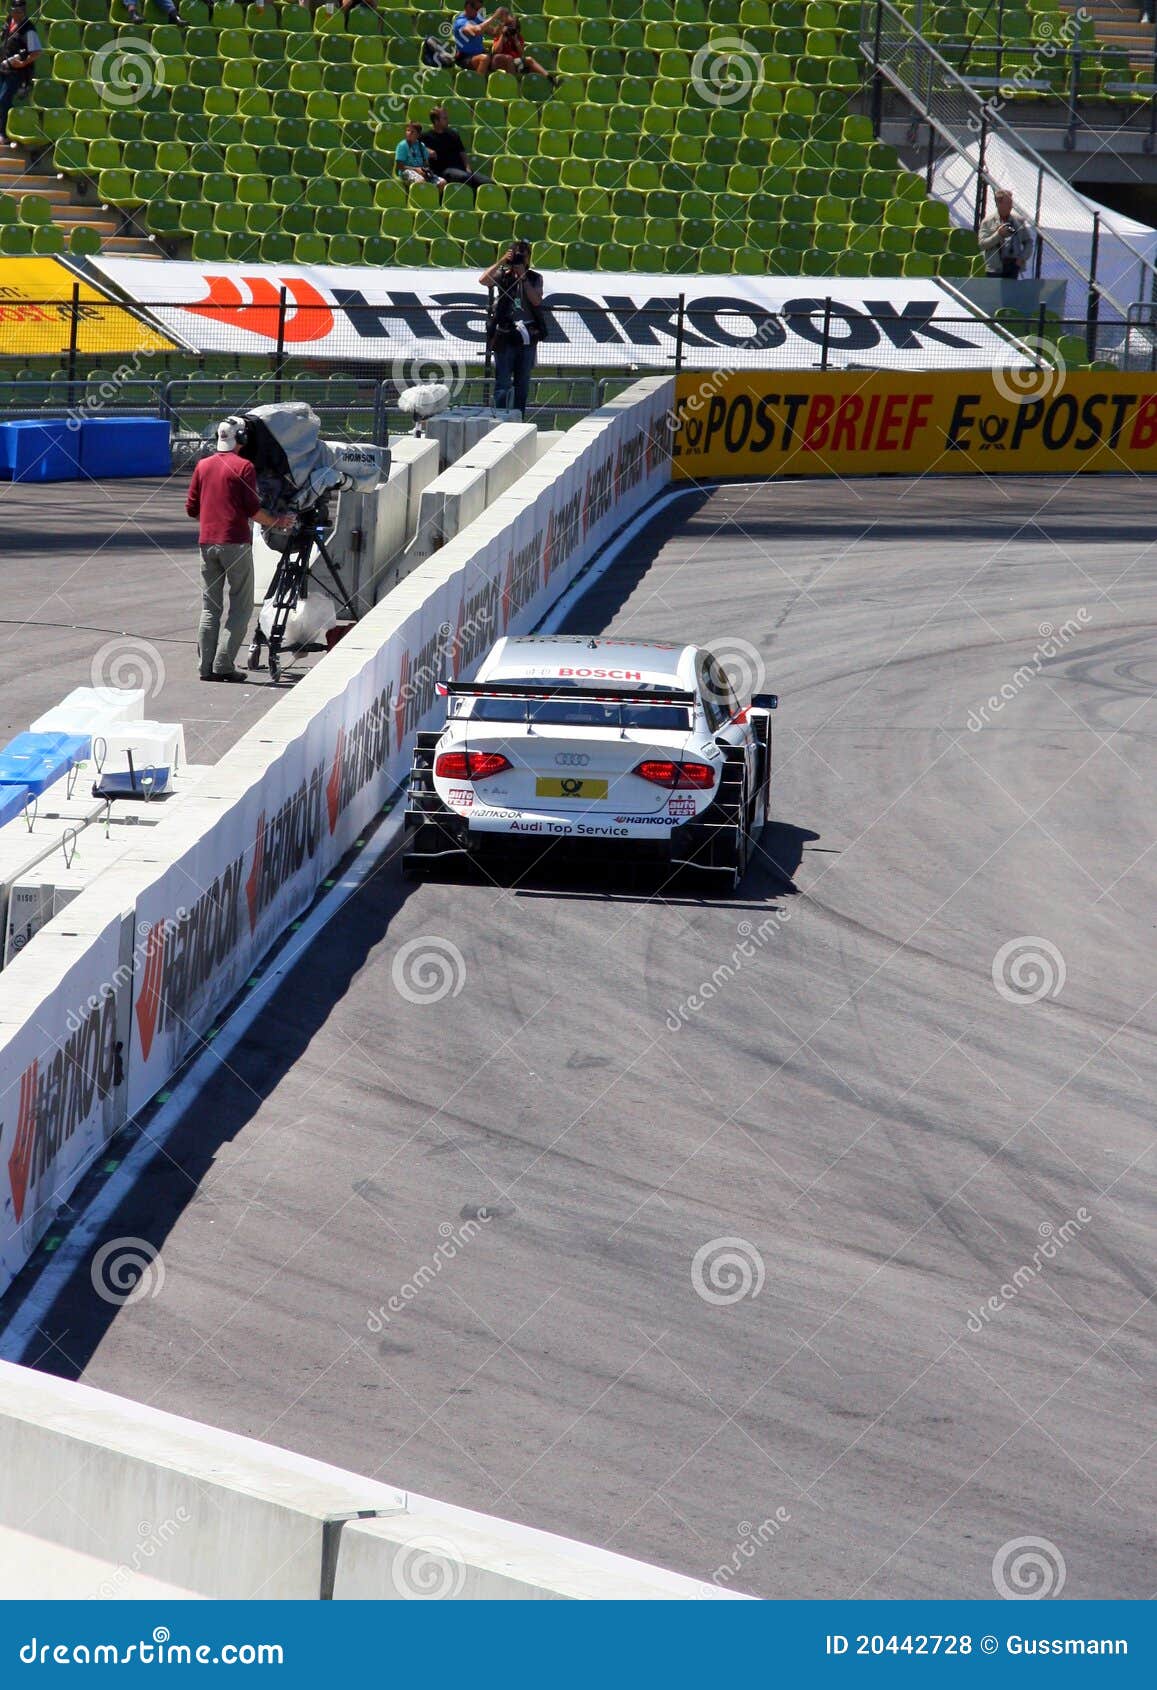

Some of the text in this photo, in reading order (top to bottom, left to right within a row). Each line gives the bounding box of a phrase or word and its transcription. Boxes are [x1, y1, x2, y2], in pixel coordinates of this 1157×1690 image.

[558, 668, 642, 680] BOSCH
[510, 820, 629, 836] Audi Top Service
